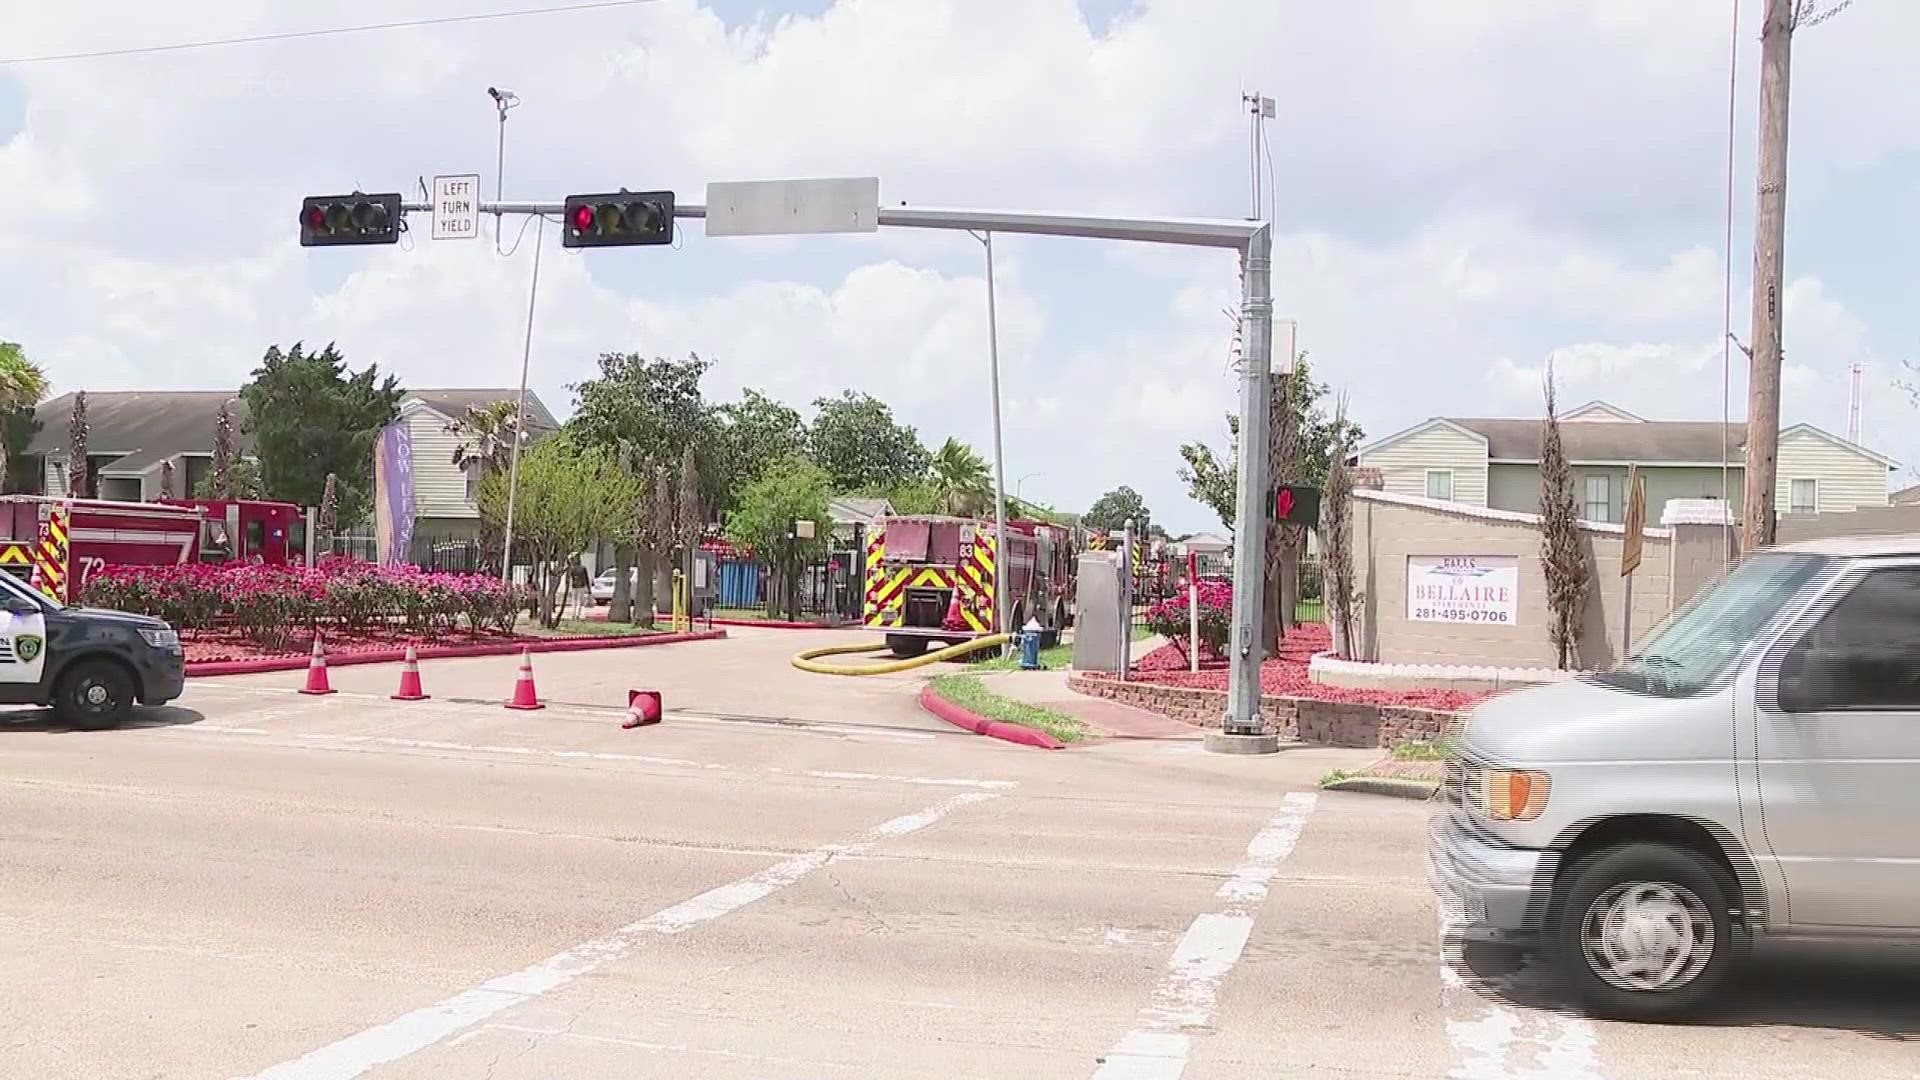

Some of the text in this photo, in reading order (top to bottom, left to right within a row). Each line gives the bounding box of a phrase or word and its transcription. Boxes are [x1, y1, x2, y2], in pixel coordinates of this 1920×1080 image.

[444, 182, 469, 195] LEFT
[442, 201, 470, 214] TURN
[441, 219, 471, 232] YIELD
[396, 427, 410, 473] NOW
[38, 522, 49, 536] 73
[1416, 585, 1509, 602] BELLAIRE
